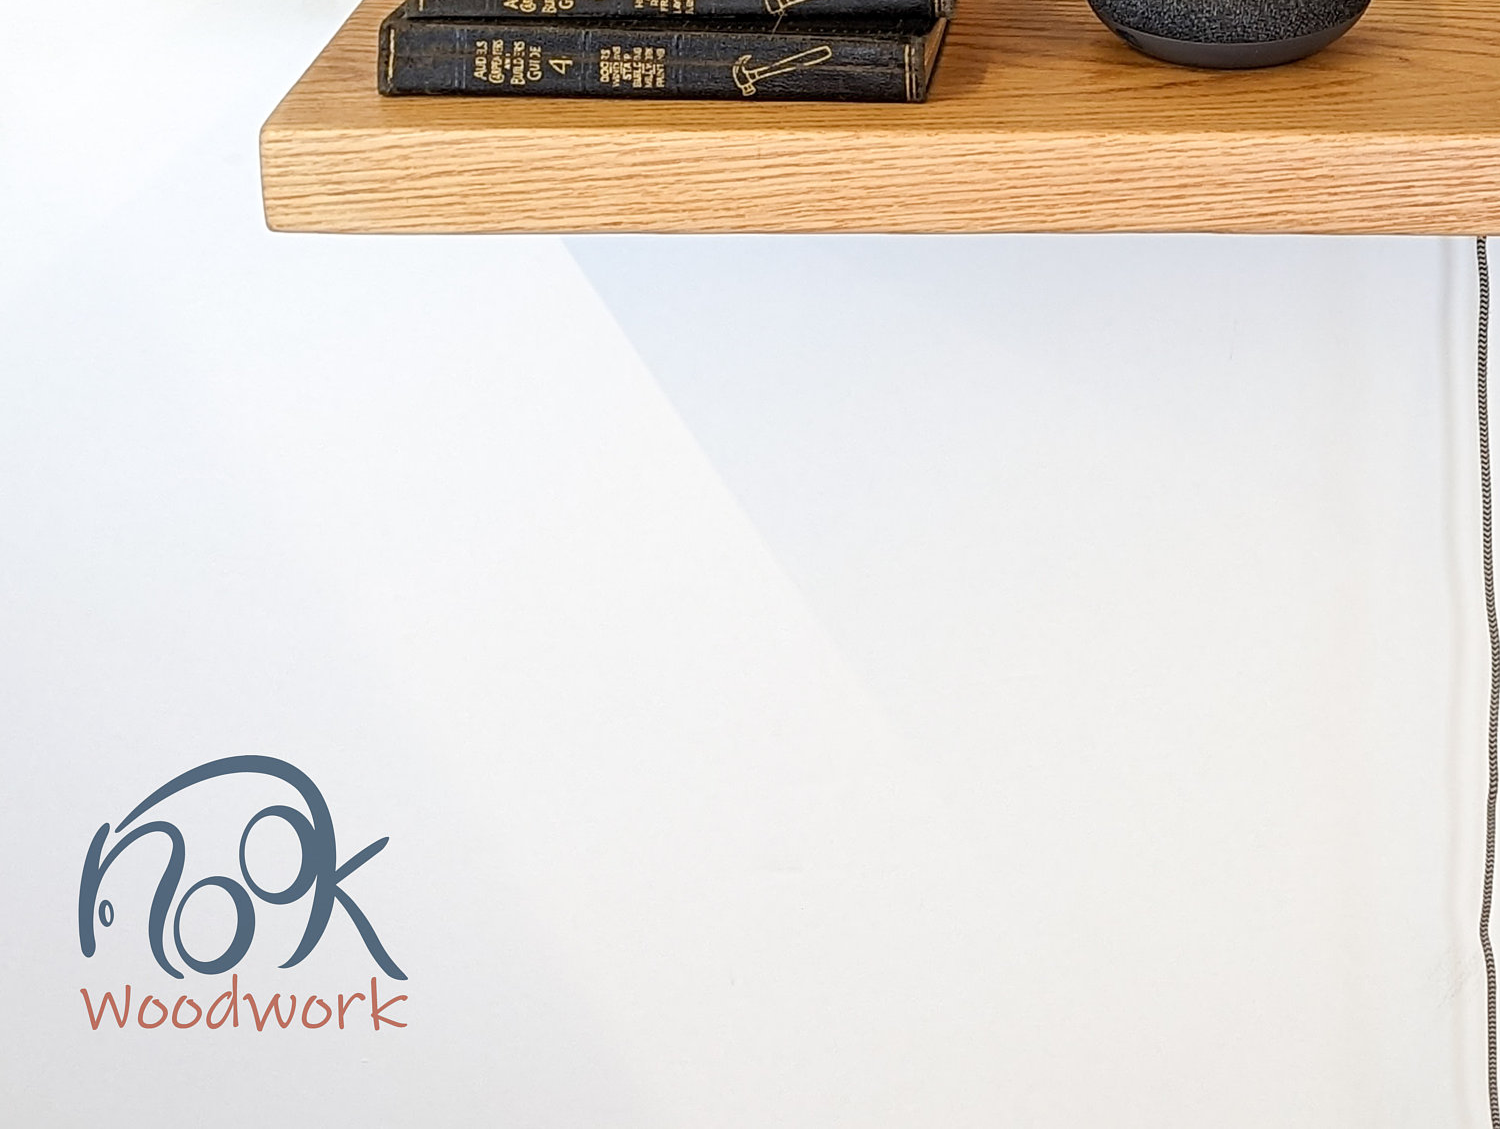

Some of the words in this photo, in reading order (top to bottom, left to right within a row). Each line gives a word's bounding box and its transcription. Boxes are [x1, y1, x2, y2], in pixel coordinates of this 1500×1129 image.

[474, 41, 487, 80] AUDELS
[489, 39, 504, 83] CARPENTERS
[510, 41, 525, 85] BUILDERS
[527, 46, 542, 81] GUIDE
[548, 59, 573, 74] 4
[600, 49, 610, 82] DOORS
[622, 53, 632, 80] STAR
[644, 47, 653, 88] MILLWRK
[656, 48, 665, 87] PAINTNG
